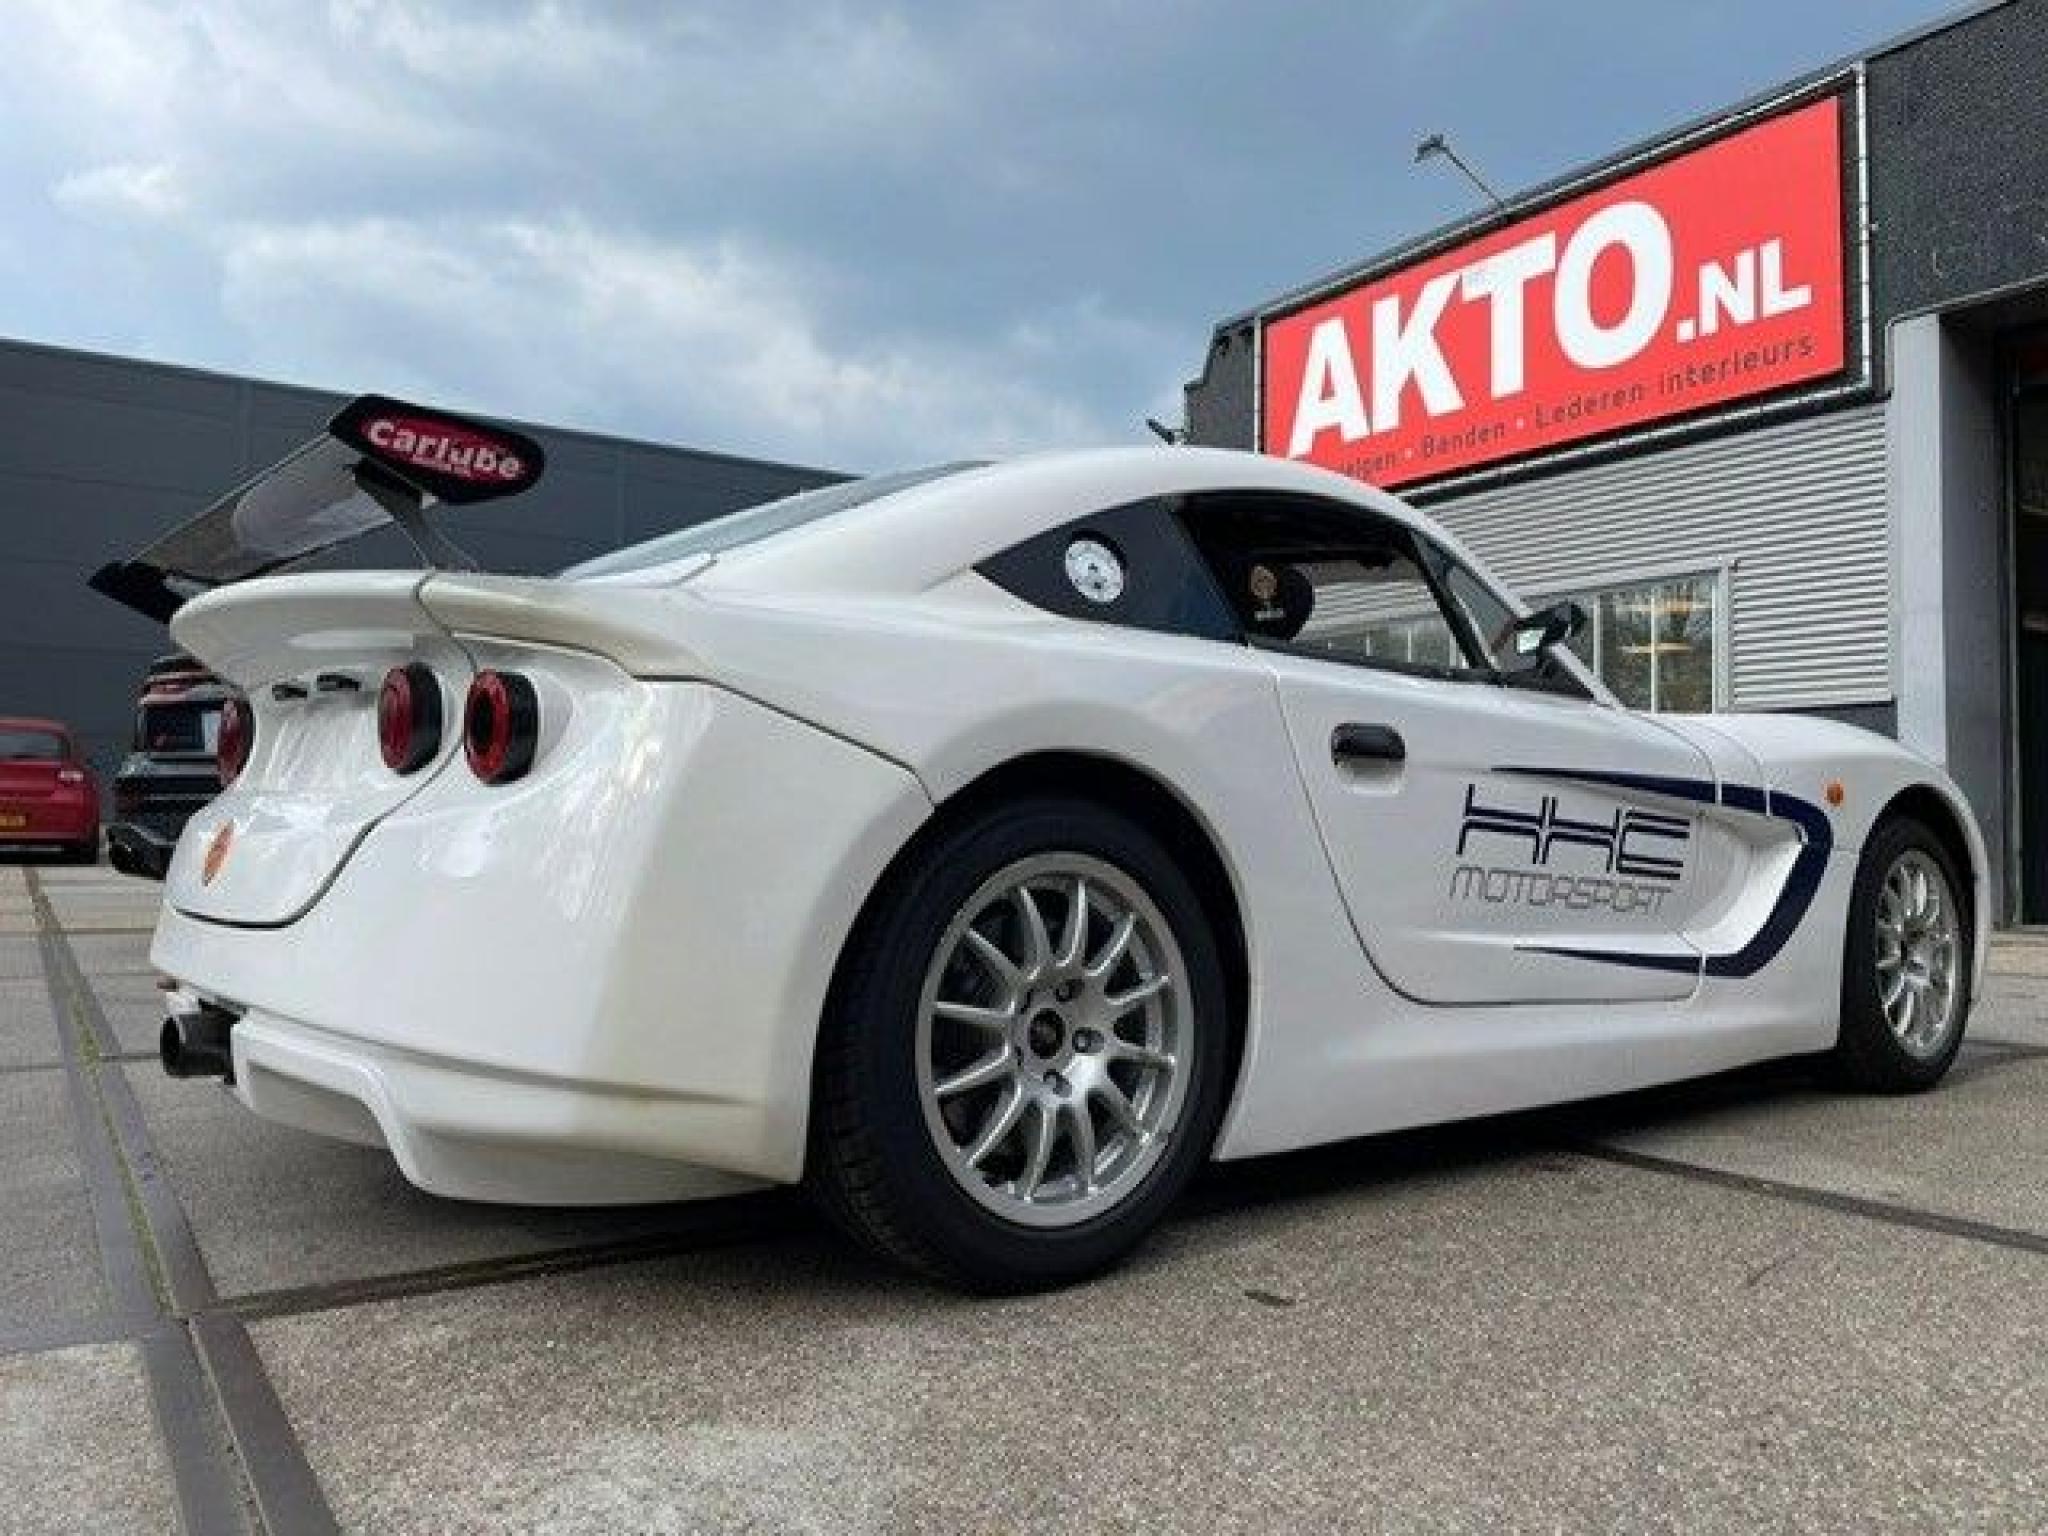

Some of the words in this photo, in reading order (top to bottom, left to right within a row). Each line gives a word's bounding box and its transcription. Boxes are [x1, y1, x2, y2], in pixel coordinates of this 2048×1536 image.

[1288, 200, 1812, 459] AKTO.NL
[1422, 420, 1505, 458] Banden
[1534, 380, 1647, 428] Lederen
[1657, 333, 1813, 396] interieurs
[1449, 866, 1672, 912] MOTORSPORT
